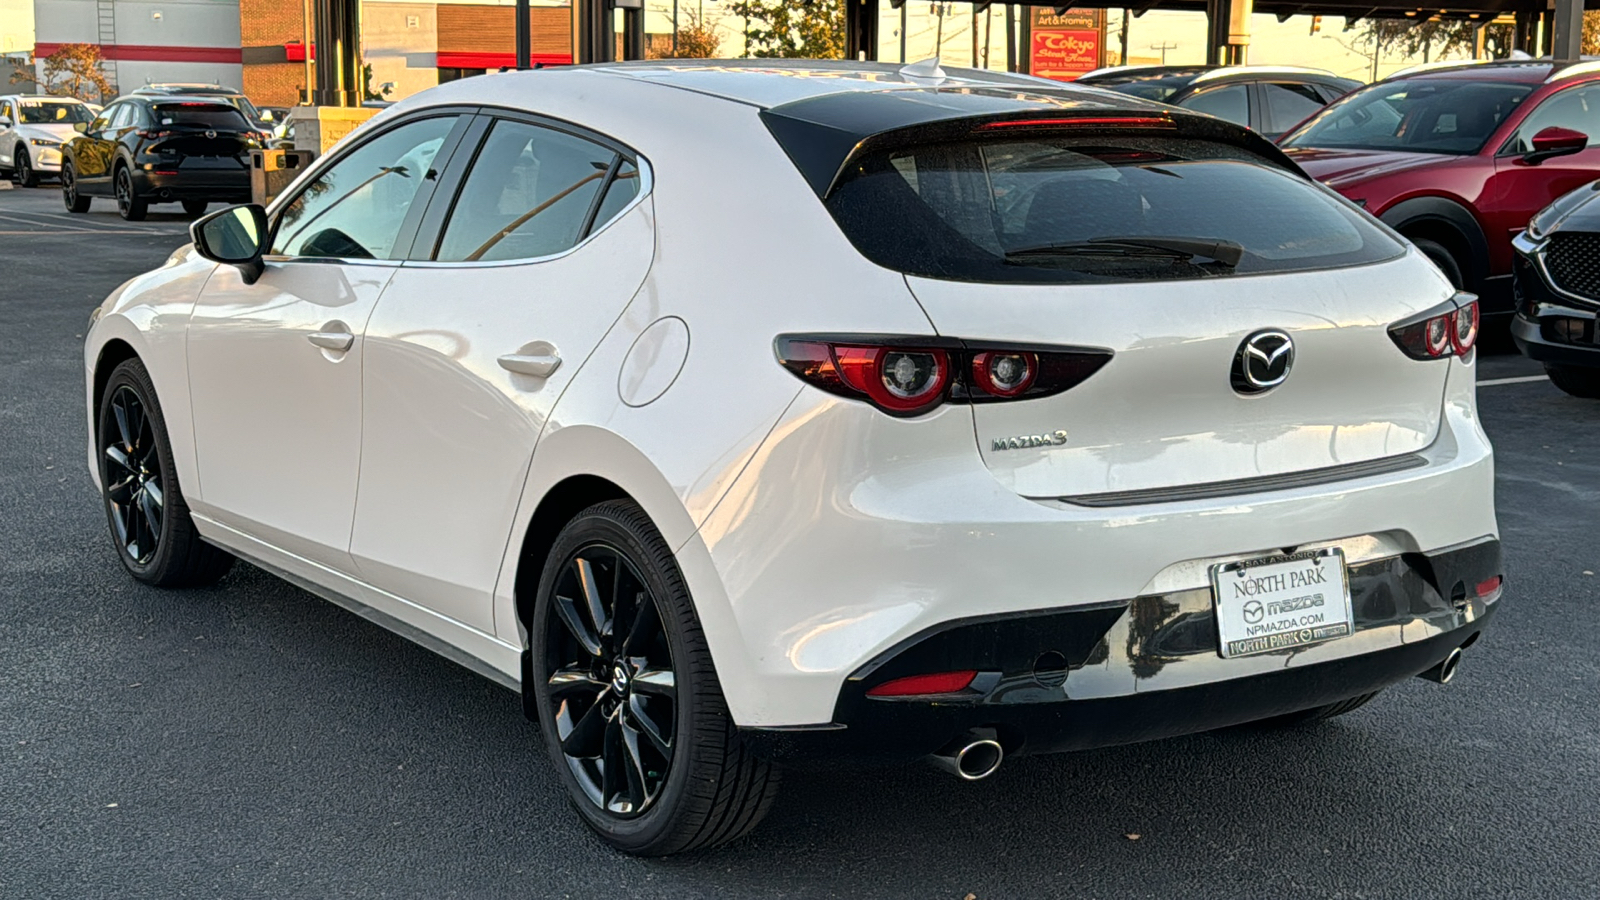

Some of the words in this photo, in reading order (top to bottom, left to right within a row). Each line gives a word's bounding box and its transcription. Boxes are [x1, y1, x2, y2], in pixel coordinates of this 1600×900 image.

[1038, 16, 1052, 25] Art
[1052, 15, 1059, 25] &
[1060, 15, 1093, 28] Framing
[1035, 33, 1094, 54] Tokyo
[992, 430, 1068, 451] MAZDA3
[1246, 558, 1266, 567] SAN
[1269, 551, 1315, 563] ANTONIO
[1233, 575, 1286, 598] NORTH
[1289, 566, 1327, 588] PARK
[1267, 593, 1325, 616] mazda
[1246, 613, 1325, 636] NPMAZDA.COM
[1230, 637, 1268, 655] NORTH
[1269, 631, 1299, 648] PARK
